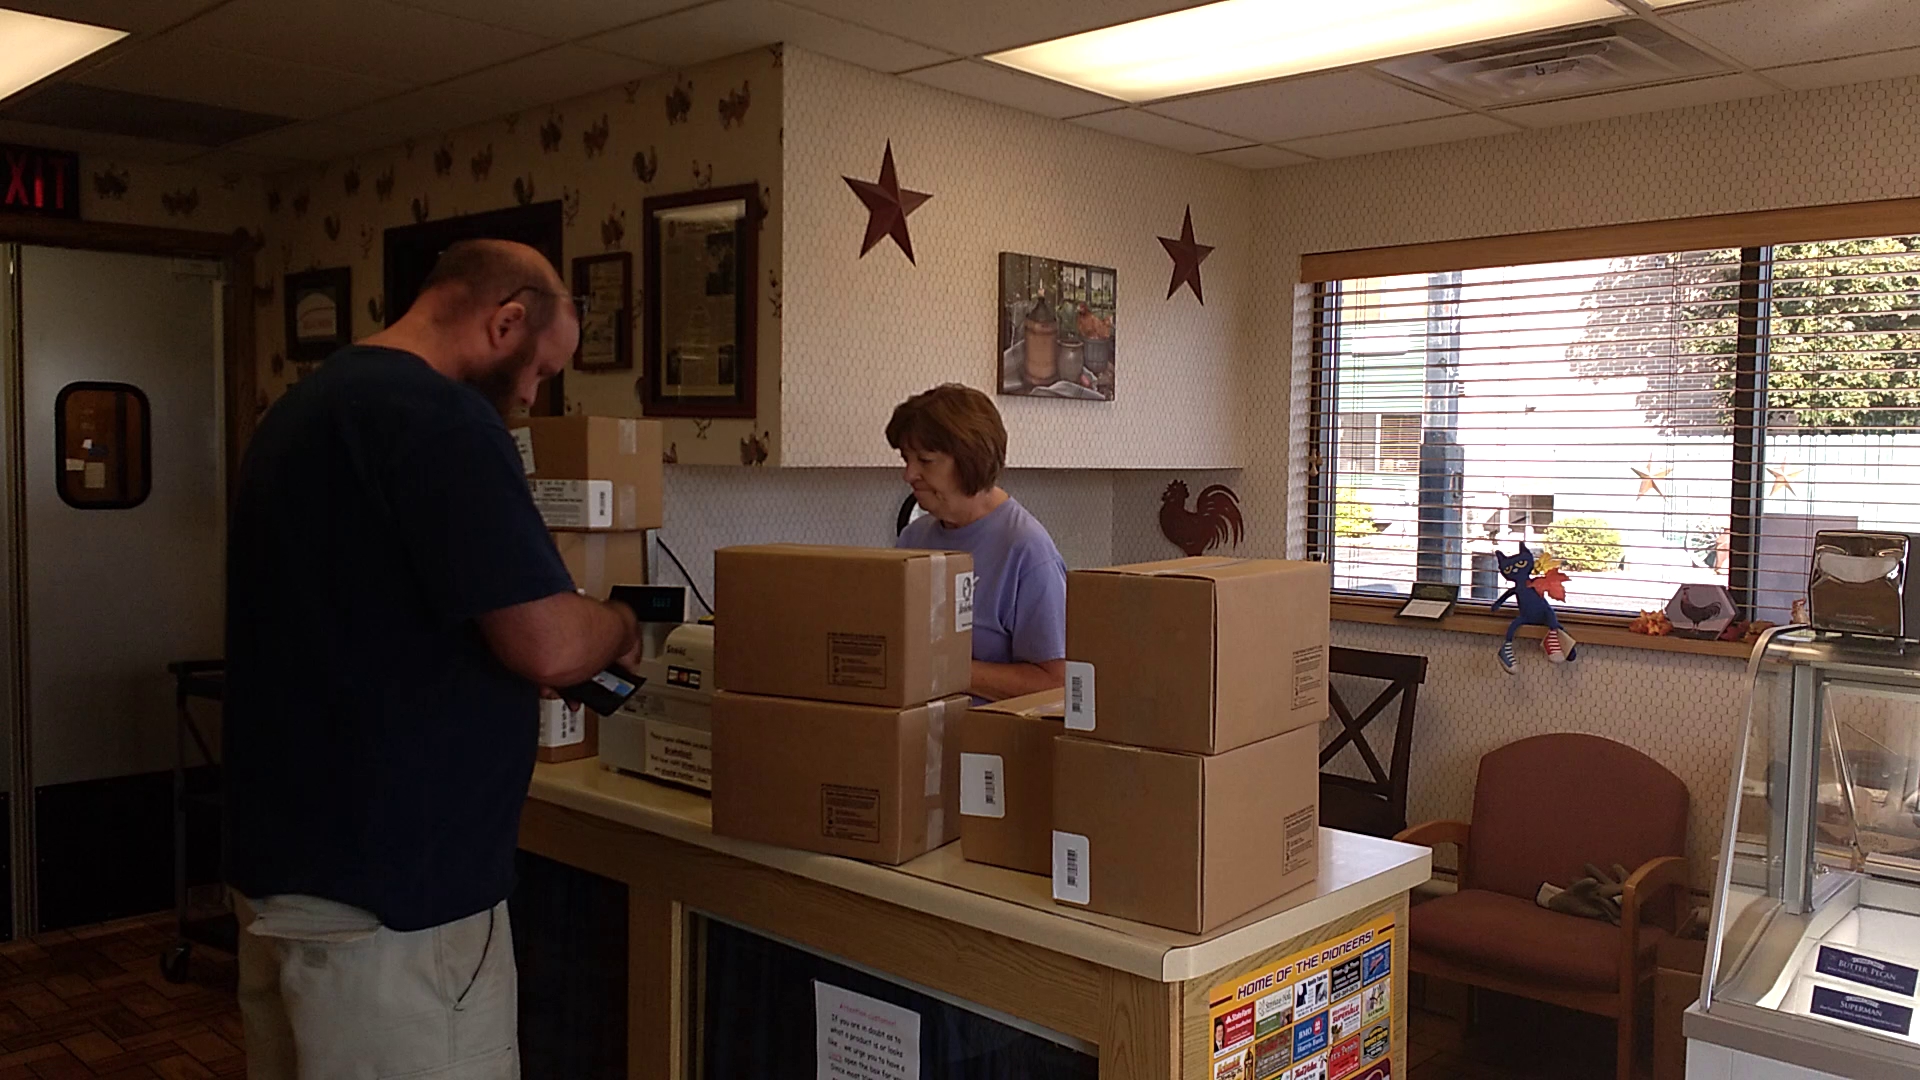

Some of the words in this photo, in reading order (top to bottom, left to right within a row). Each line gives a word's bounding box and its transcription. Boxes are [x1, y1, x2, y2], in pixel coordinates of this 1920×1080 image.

[4, 150, 71, 209] XIT
[1237, 974, 1273, 1000] HOME
[1276, 966, 1292, 983] OF
[1296, 955, 1318, 973] THE
[1321, 930, 1373, 963] PIONEERS!
[1838, 959, 1868, 973] BUTTER
[1871, 968, 1896, 980] PECAN
[1840, 1000, 1883, 1017] SUPERMAN
[832, 1013, 838, 1021] If
[840, 1019, 849, 1027] you
[868, 1027, 885, 1037] doubt
[886, 1034, 893, 1042] as
[894, 1036, 901, 1044] to
[1298, 1026, 1312, 1040] BMO
[830, 1027, 844, 1036] what
[850, 1033, 872, 1046] product
[873, 1042, 879, 1050] is
[888, 1045, 903, 1058] looks
[1312, 1036, 1324, 1046] Bank
[853, 1048, 866, 1058] urge
[867, 1054, 877, 1062] you
[879, 1056, 885, 1064] to
[886, 1058, 900, 1070] have
